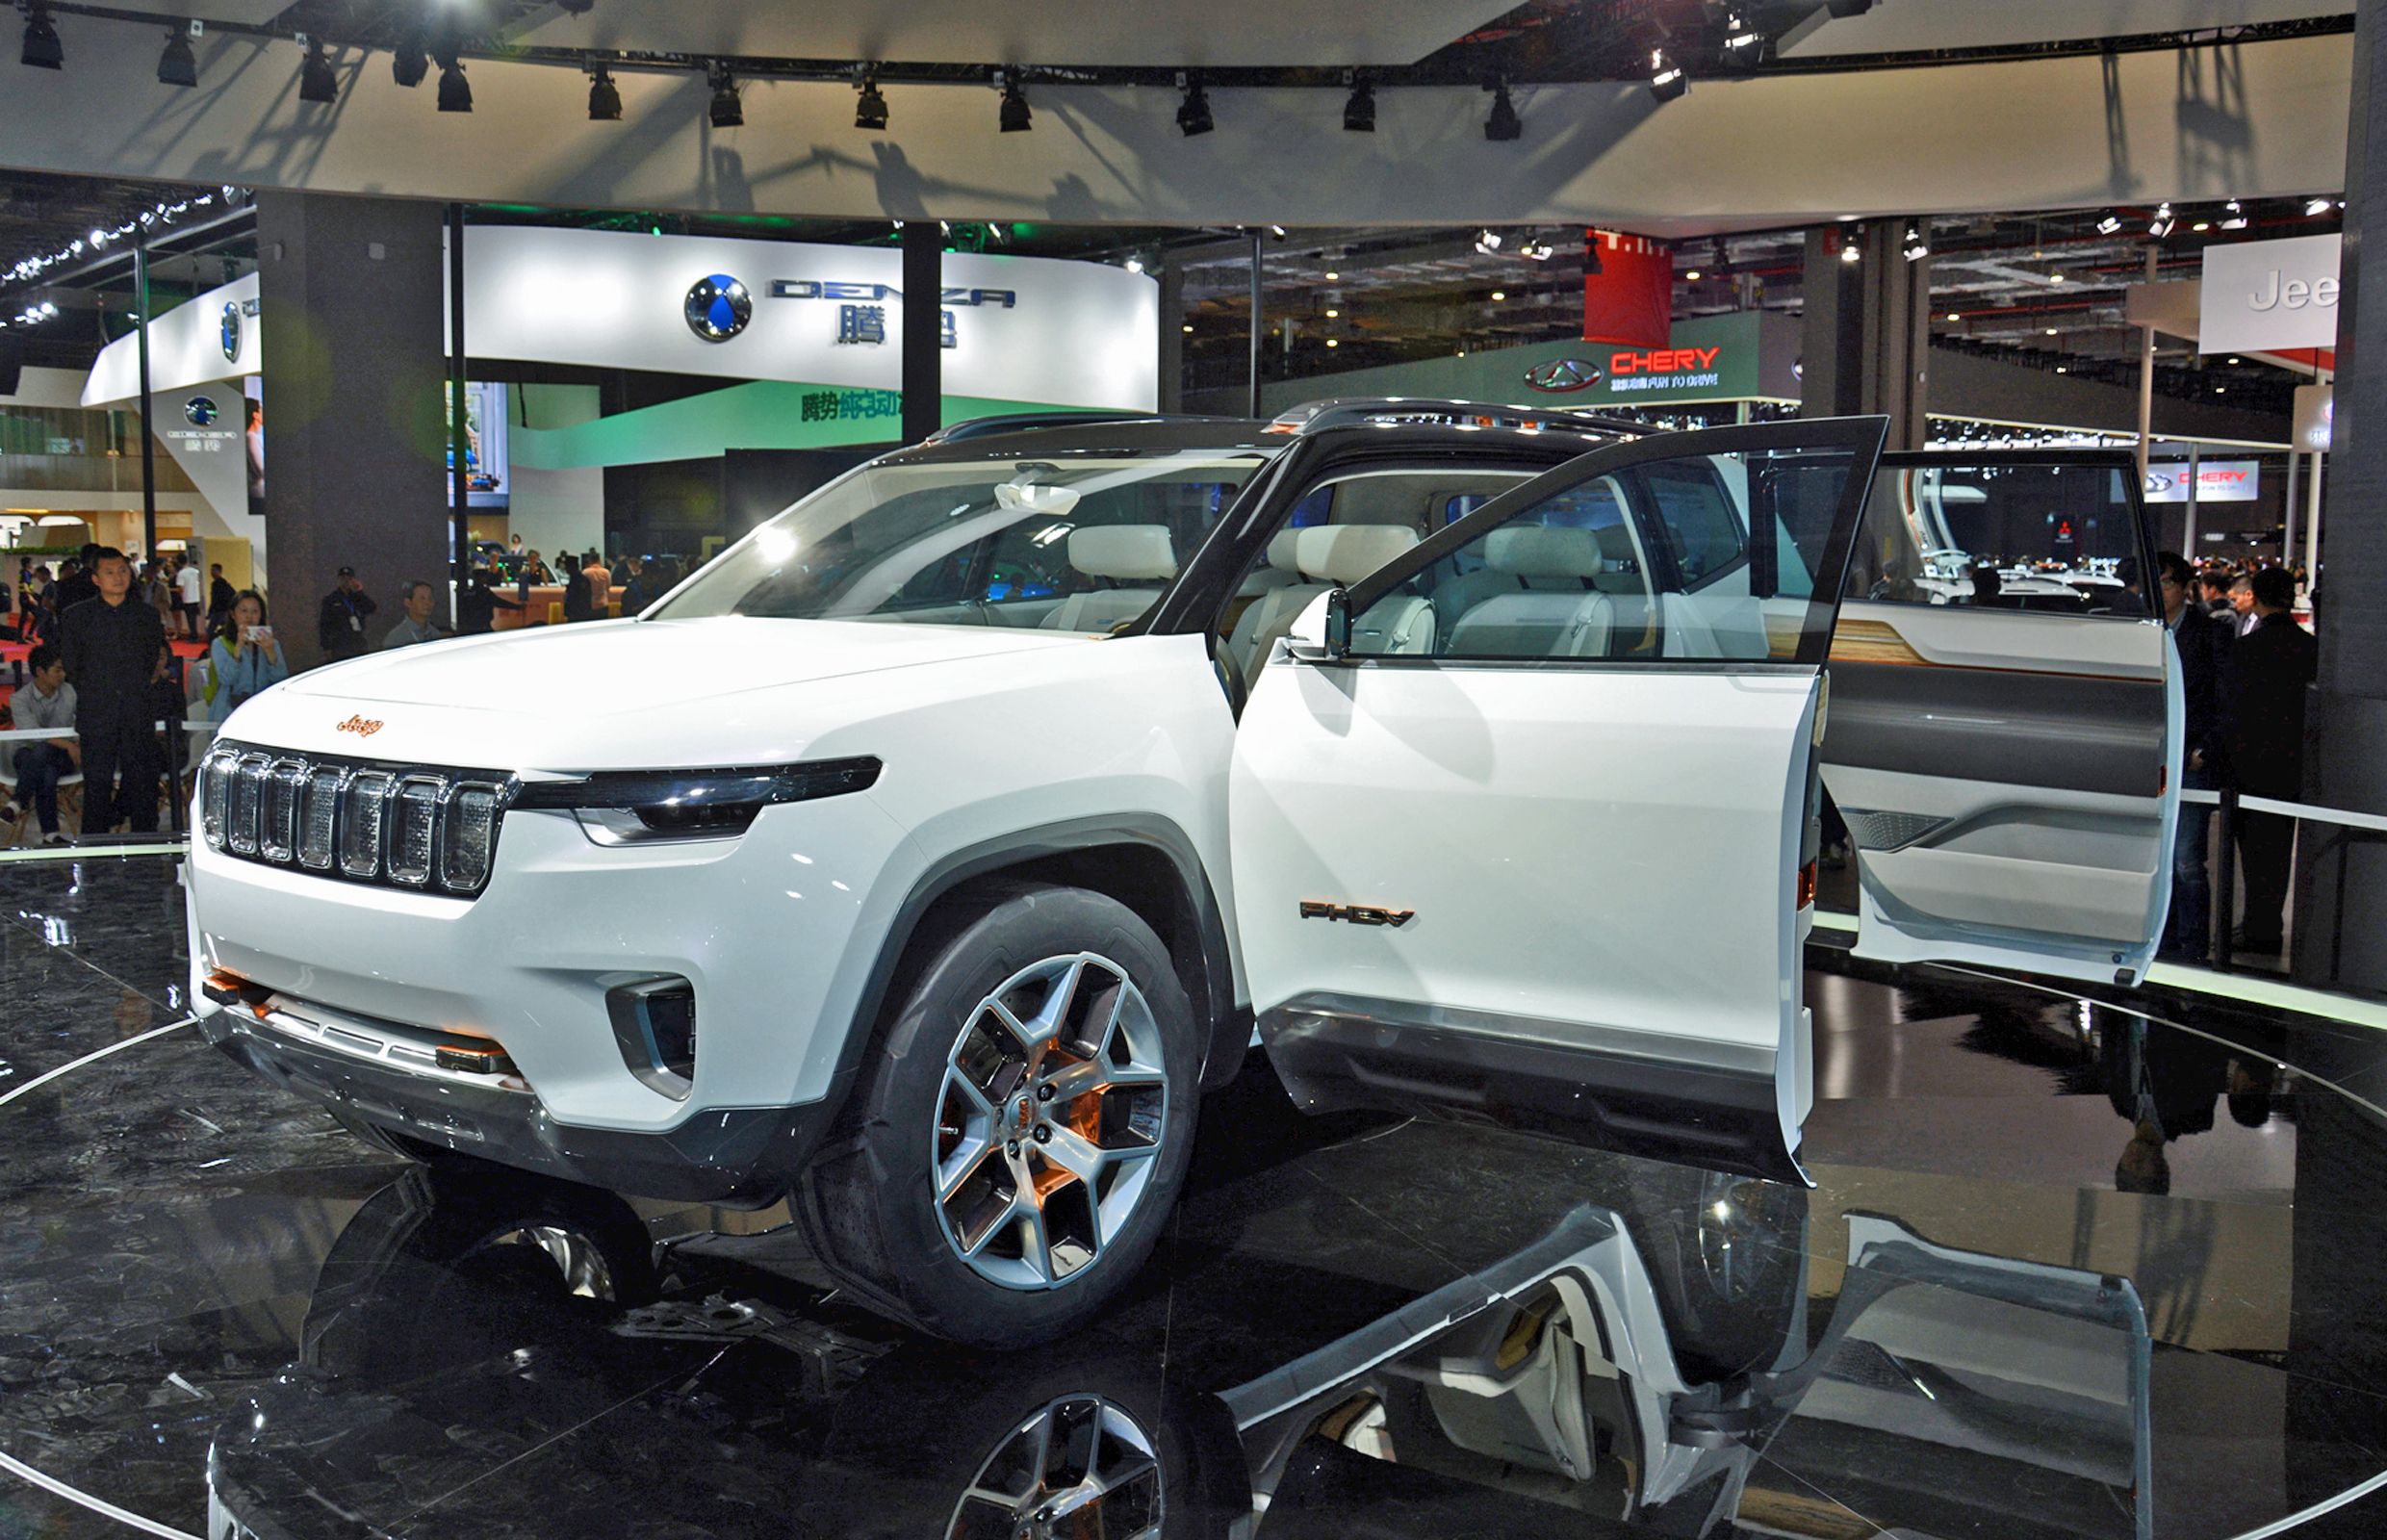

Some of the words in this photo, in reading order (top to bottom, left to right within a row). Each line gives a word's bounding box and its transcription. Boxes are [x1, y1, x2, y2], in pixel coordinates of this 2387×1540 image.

[2247, 269, 2340, 312] Jee
[1610, 346, 1720, 373] CHERY
[1672, 376, 1685, 387] TO
[801, 389, 903, 422] 腾势纯电动
[2178, 471, 2247, 483] CHERY
[336, 714, 384, 737] Jeep
[1299, 901, 1415, 927] PHEV
